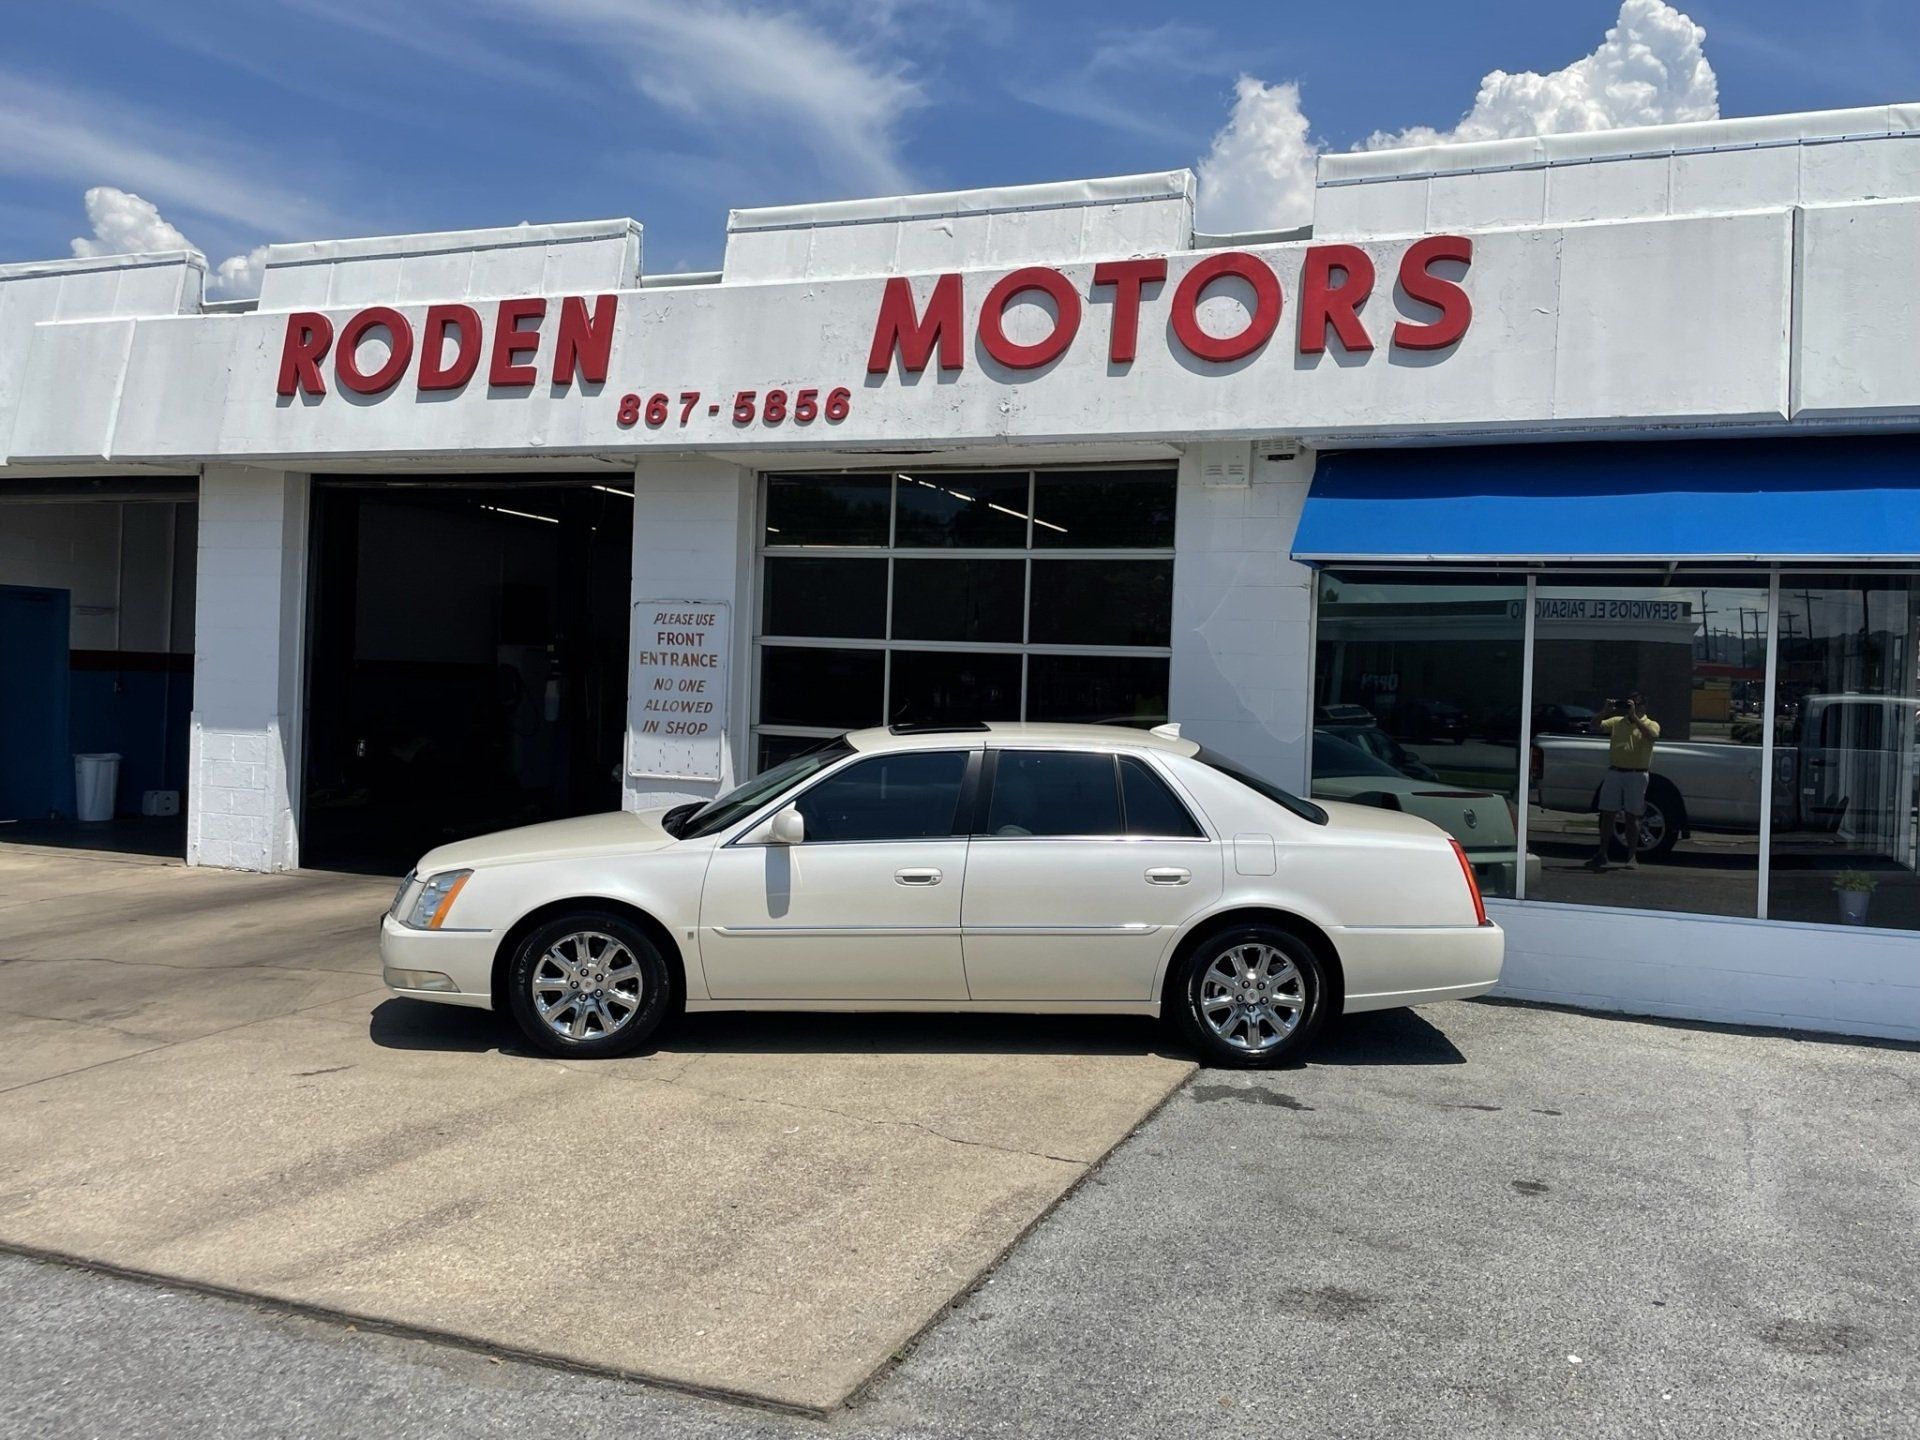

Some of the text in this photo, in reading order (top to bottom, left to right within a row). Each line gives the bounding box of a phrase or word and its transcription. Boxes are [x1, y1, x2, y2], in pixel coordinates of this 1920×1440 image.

[276, 234, 1473, 396] RODEN MOTORS
[617, 386, 851, 426] 867-5856
[653, 613, 716, 626] PLEASE USE
[657, 632, 704, 646] FRONT
[640, 651, 718, 667] ENTRANCE
[654, 678, 706, 693] NO ONE
[644, 699, 713, 714] ALLOWED
[642, 720, 708, 735] IN SHOP
